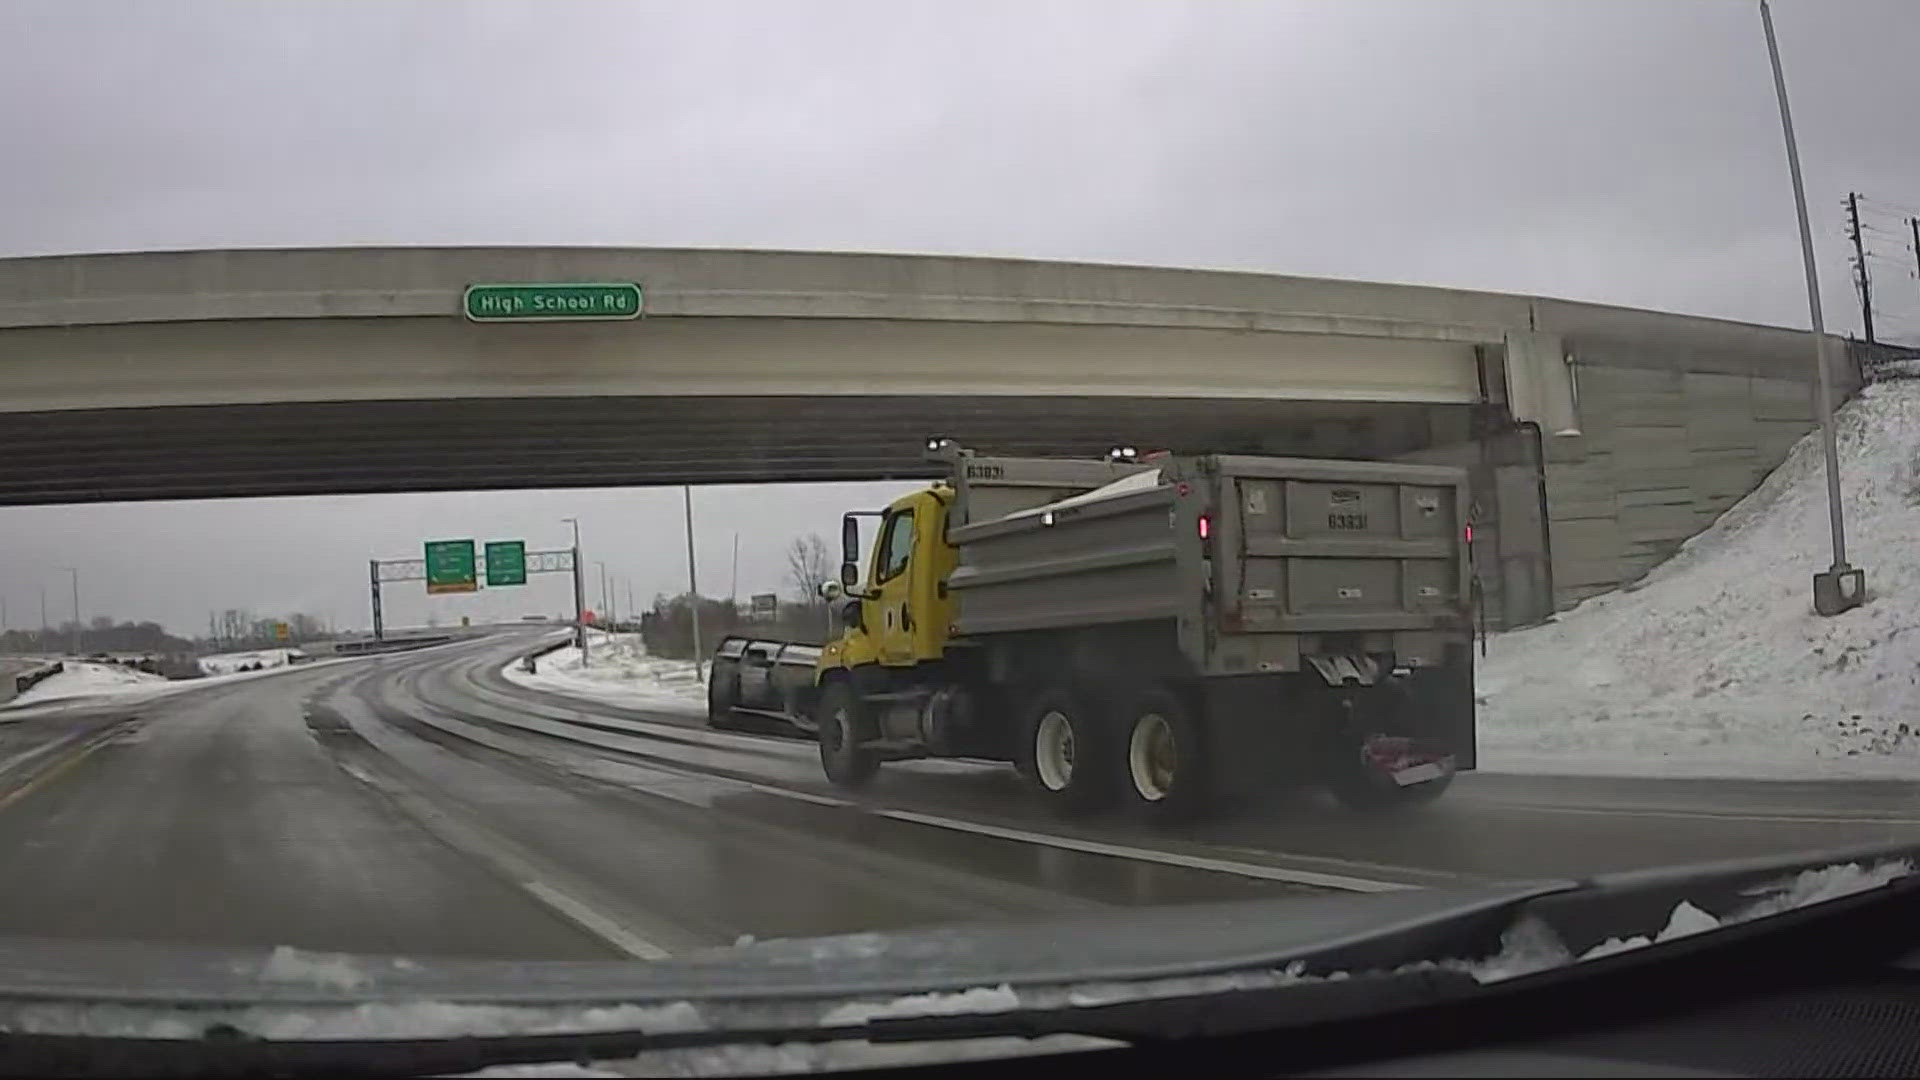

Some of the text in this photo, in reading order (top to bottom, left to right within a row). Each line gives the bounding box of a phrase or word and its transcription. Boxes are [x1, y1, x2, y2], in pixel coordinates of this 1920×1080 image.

[481, 294, 626, 314] High School Rd
